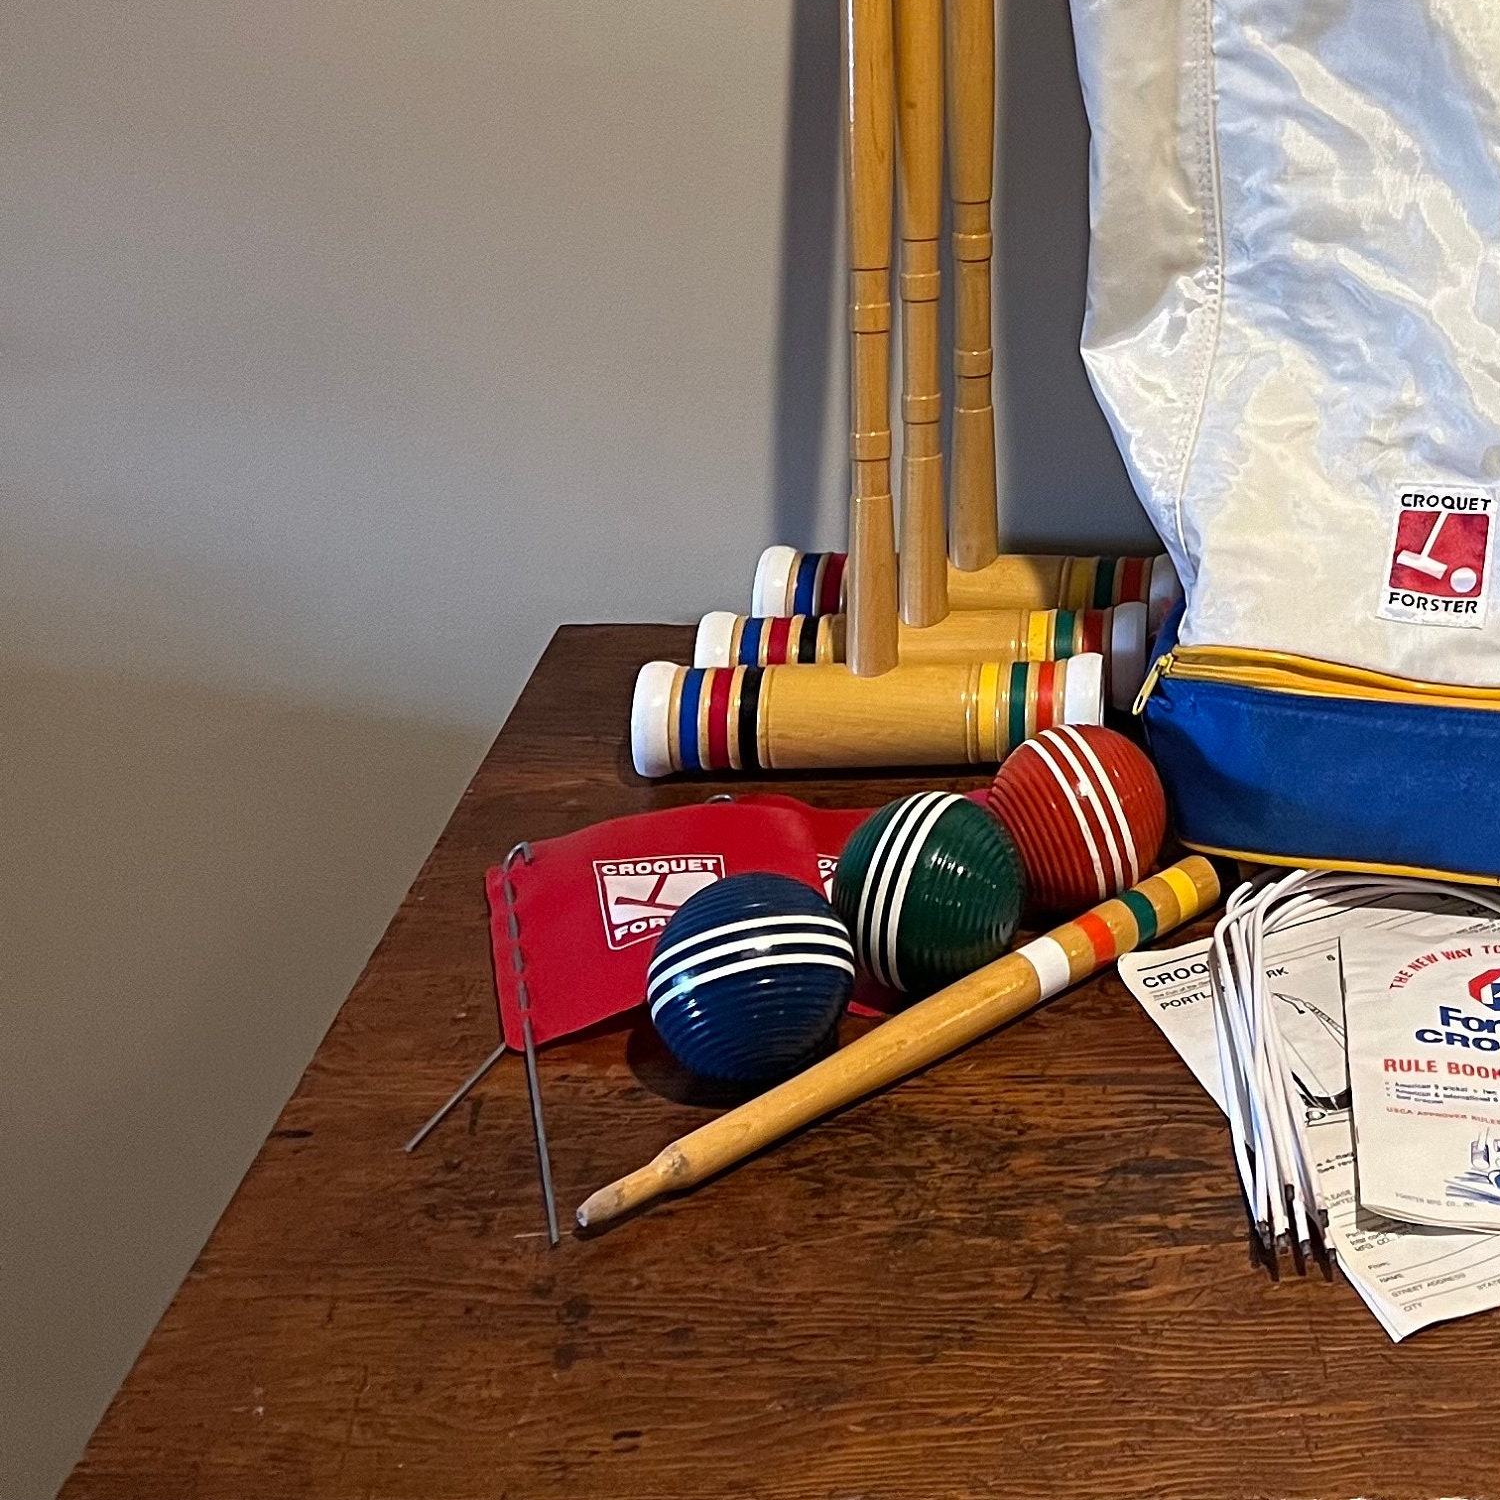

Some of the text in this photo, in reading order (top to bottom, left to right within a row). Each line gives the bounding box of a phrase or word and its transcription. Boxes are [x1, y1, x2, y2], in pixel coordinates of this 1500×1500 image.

[1400, 493, 1492, 511] CROQUET
[1388, 592, 1478, 614] FORSTER
[601, 859, 718, 875] CROQUET
[1142, 960, 1210, 988] CROQ
[1265, 966, 1290, 978] RK
[1389, 969, 1414, 990] THE
[1408, 953, 1439, 972] NEW
[1441, 948, 1473, 960] WAY
[1159, 991, 1213, 1010] PORTL
[1384, 1058, 1439, 1073] RULE
[1391, 1284, 1424, 1298] STREET
[1403, 1301, 1423, 1312] CITY
